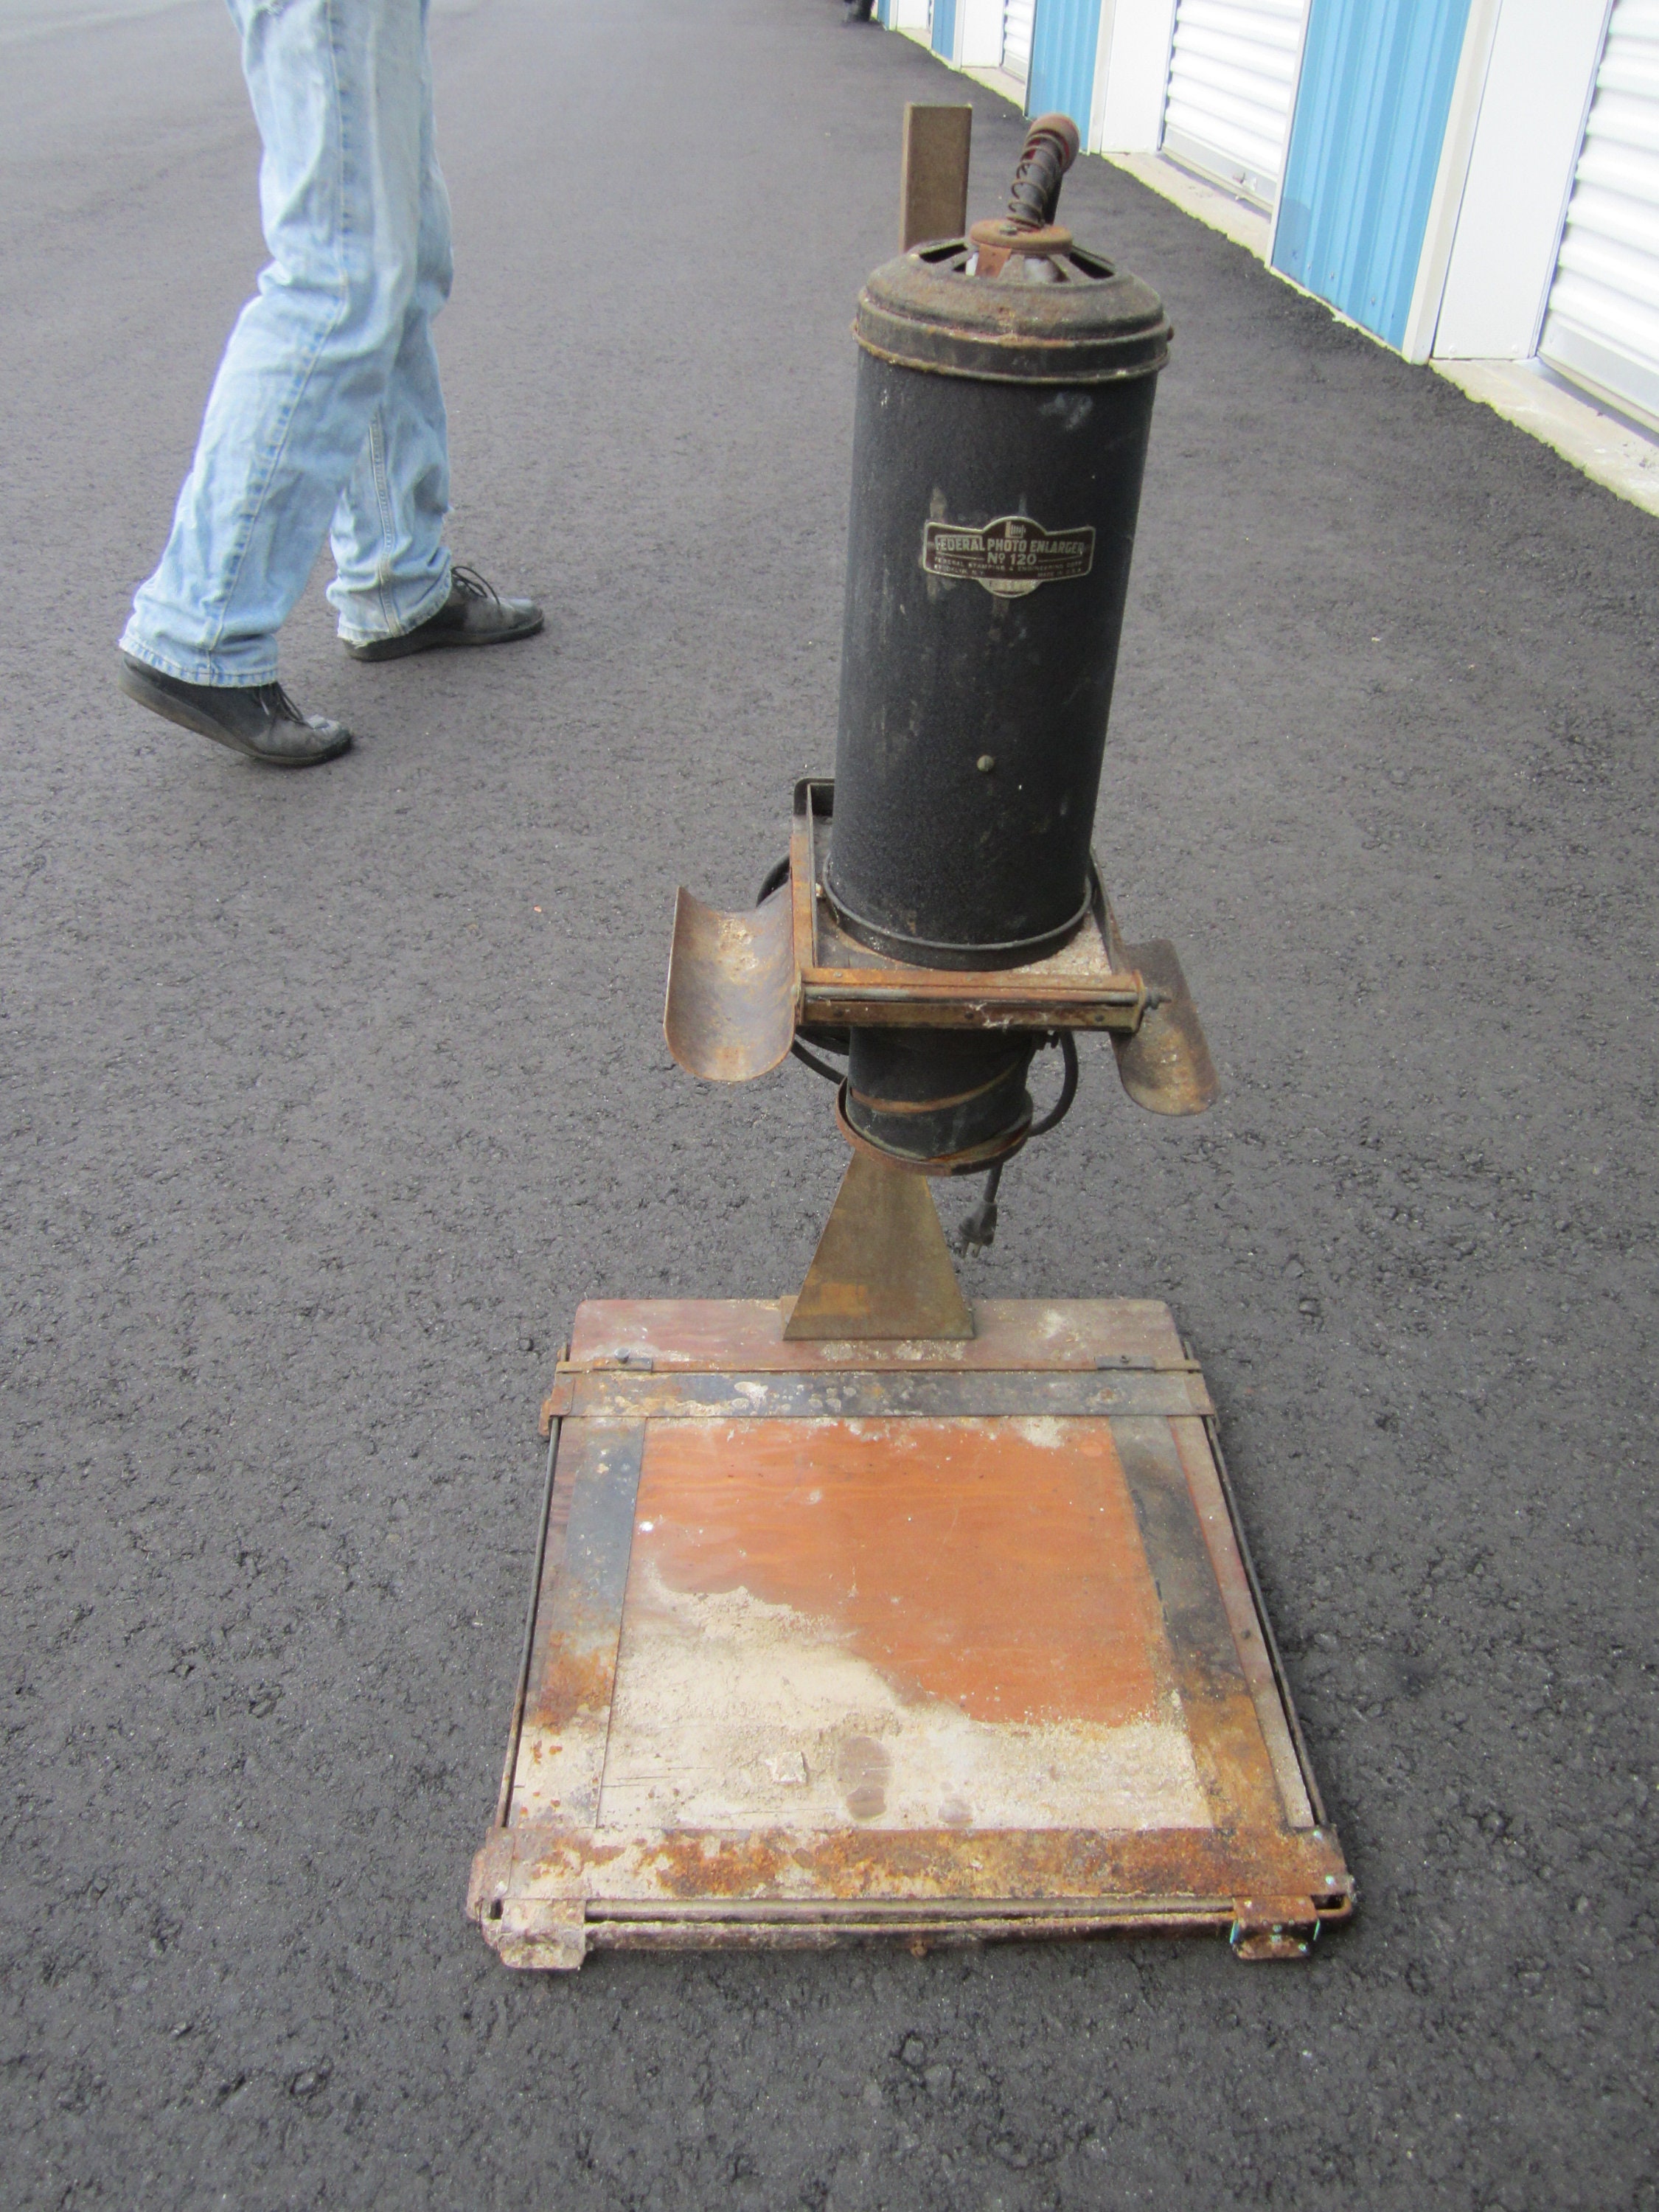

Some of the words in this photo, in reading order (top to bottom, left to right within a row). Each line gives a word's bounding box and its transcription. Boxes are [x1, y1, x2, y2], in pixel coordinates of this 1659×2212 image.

[935, 535, 985, 552] FEDERAL
[987, 538, 1027, 552] PHOTO
[1029, 540, 1085, 554] ENLARGER
[1010, 553, 1037, 566] 120
